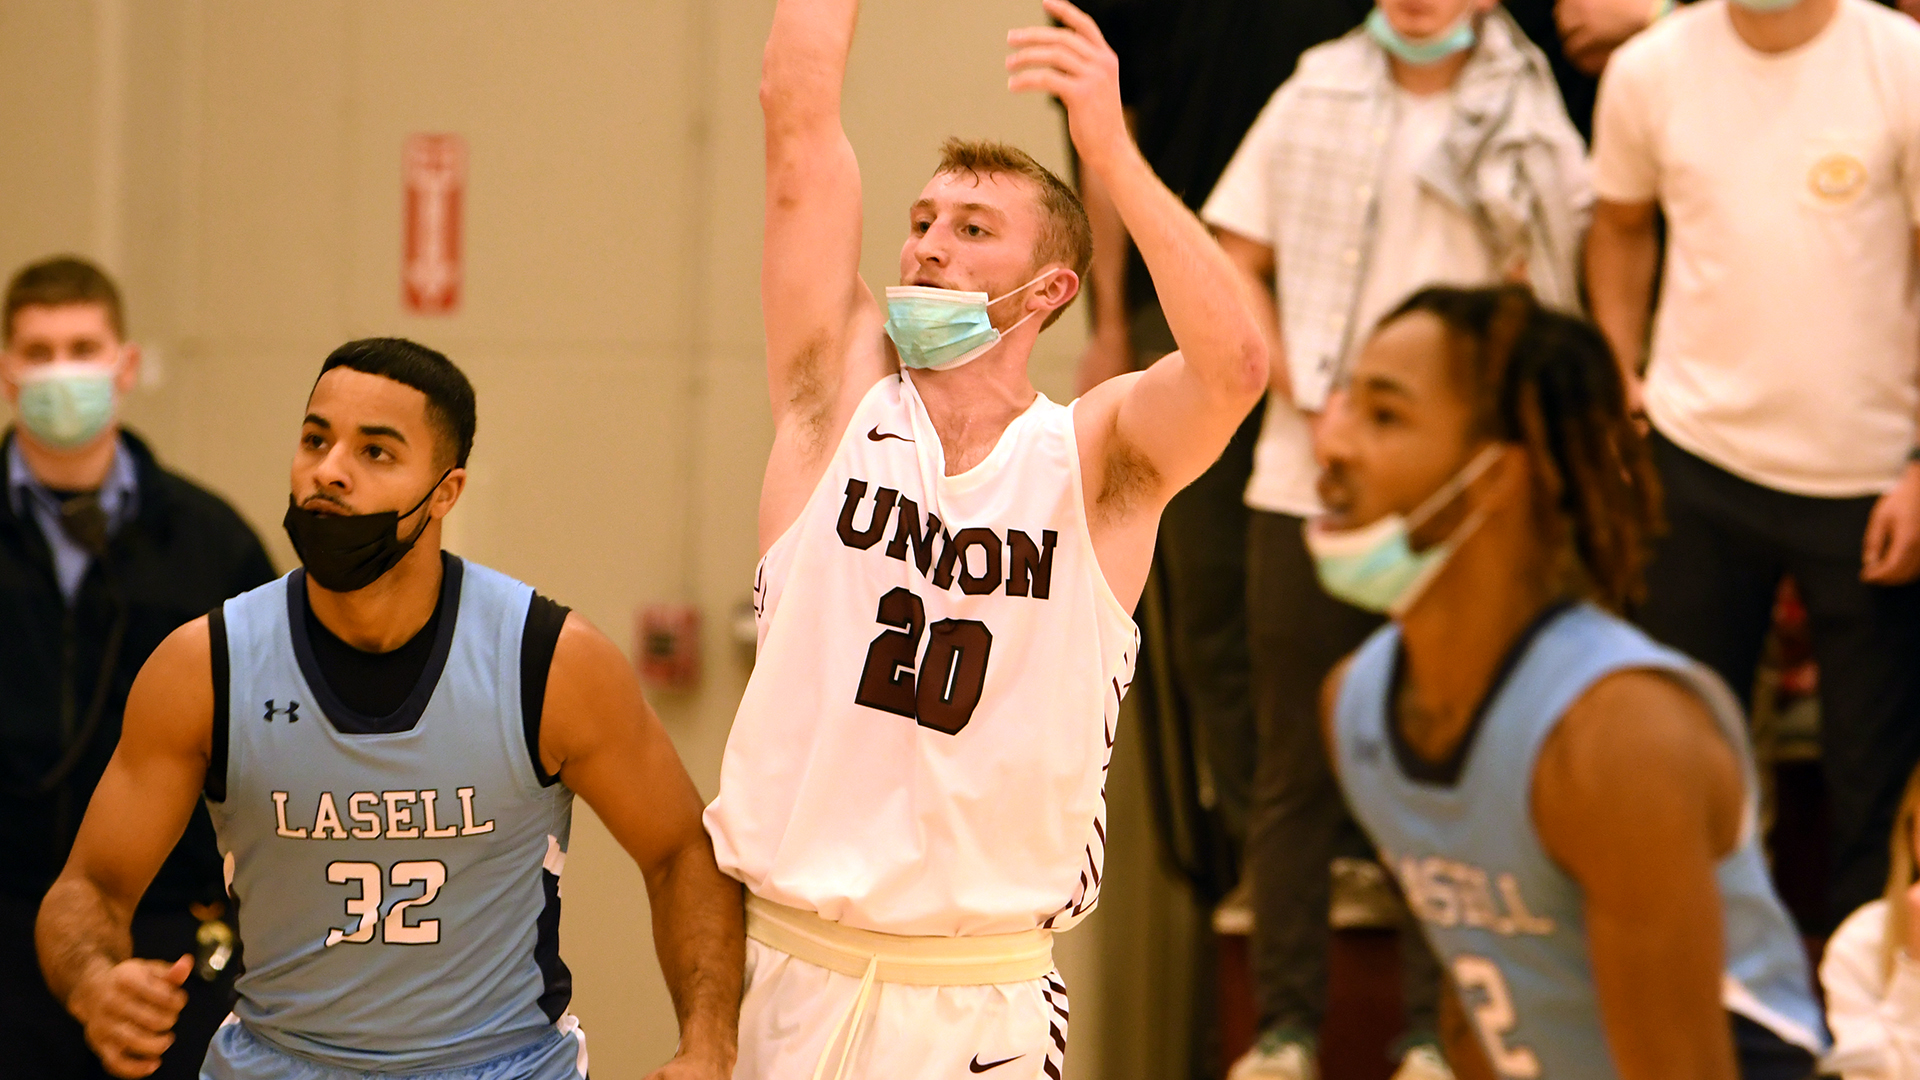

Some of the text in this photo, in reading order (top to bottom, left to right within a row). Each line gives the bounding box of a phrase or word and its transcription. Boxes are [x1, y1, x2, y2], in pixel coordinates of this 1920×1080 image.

[836, 478, 1057, 600] UNION
[854, 587, 993, 736] 20
[272, 786, 495, 840] LASELL
[325, 860, 447, 947] 32
